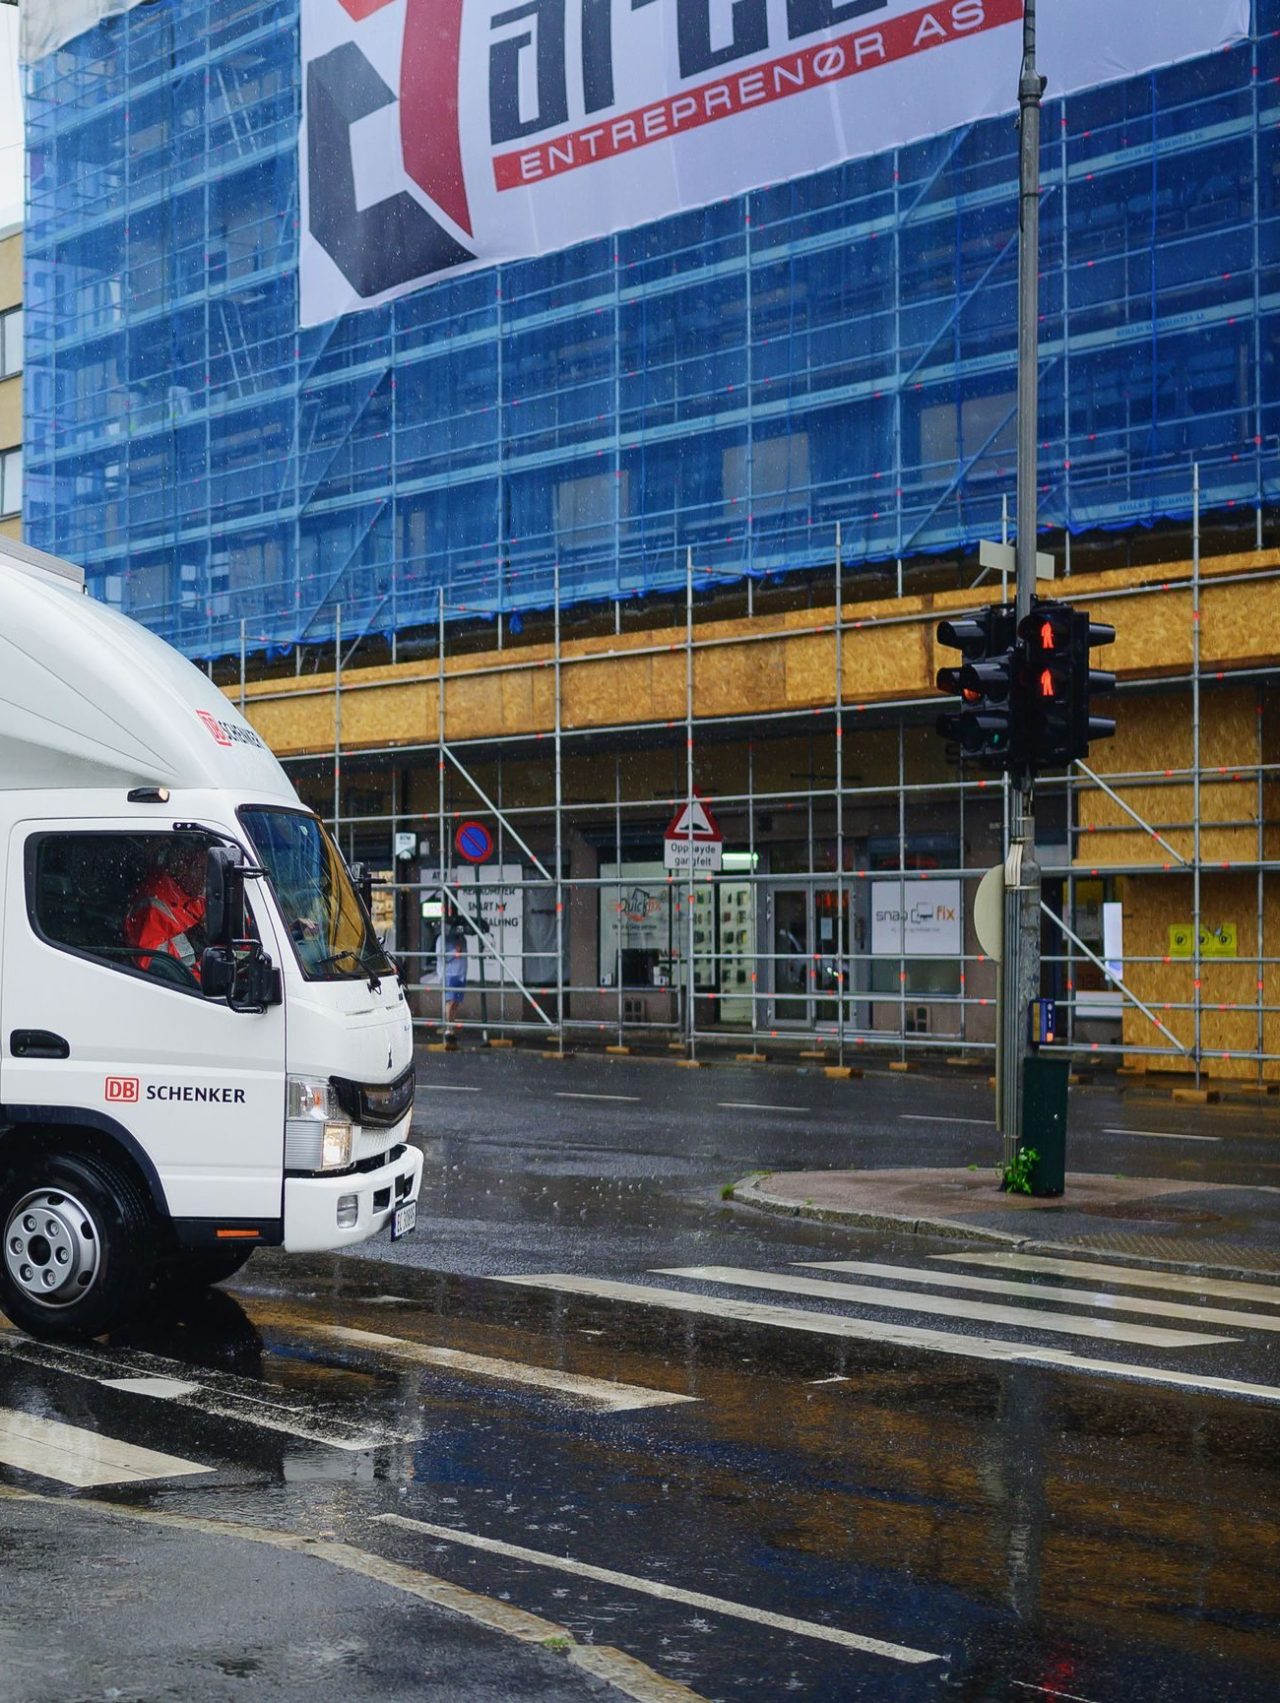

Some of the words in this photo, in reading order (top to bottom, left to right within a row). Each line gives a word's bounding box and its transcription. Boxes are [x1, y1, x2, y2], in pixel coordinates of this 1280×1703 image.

[520, 31, 886, 180] ENTREPRENØR
[912, 0, 987, 46] AS
[670, 843, 716, 855] Oppøyde
[108, 1079, 137, 1101] DB
[146, 1085, 246, 1104] SCHENKER
